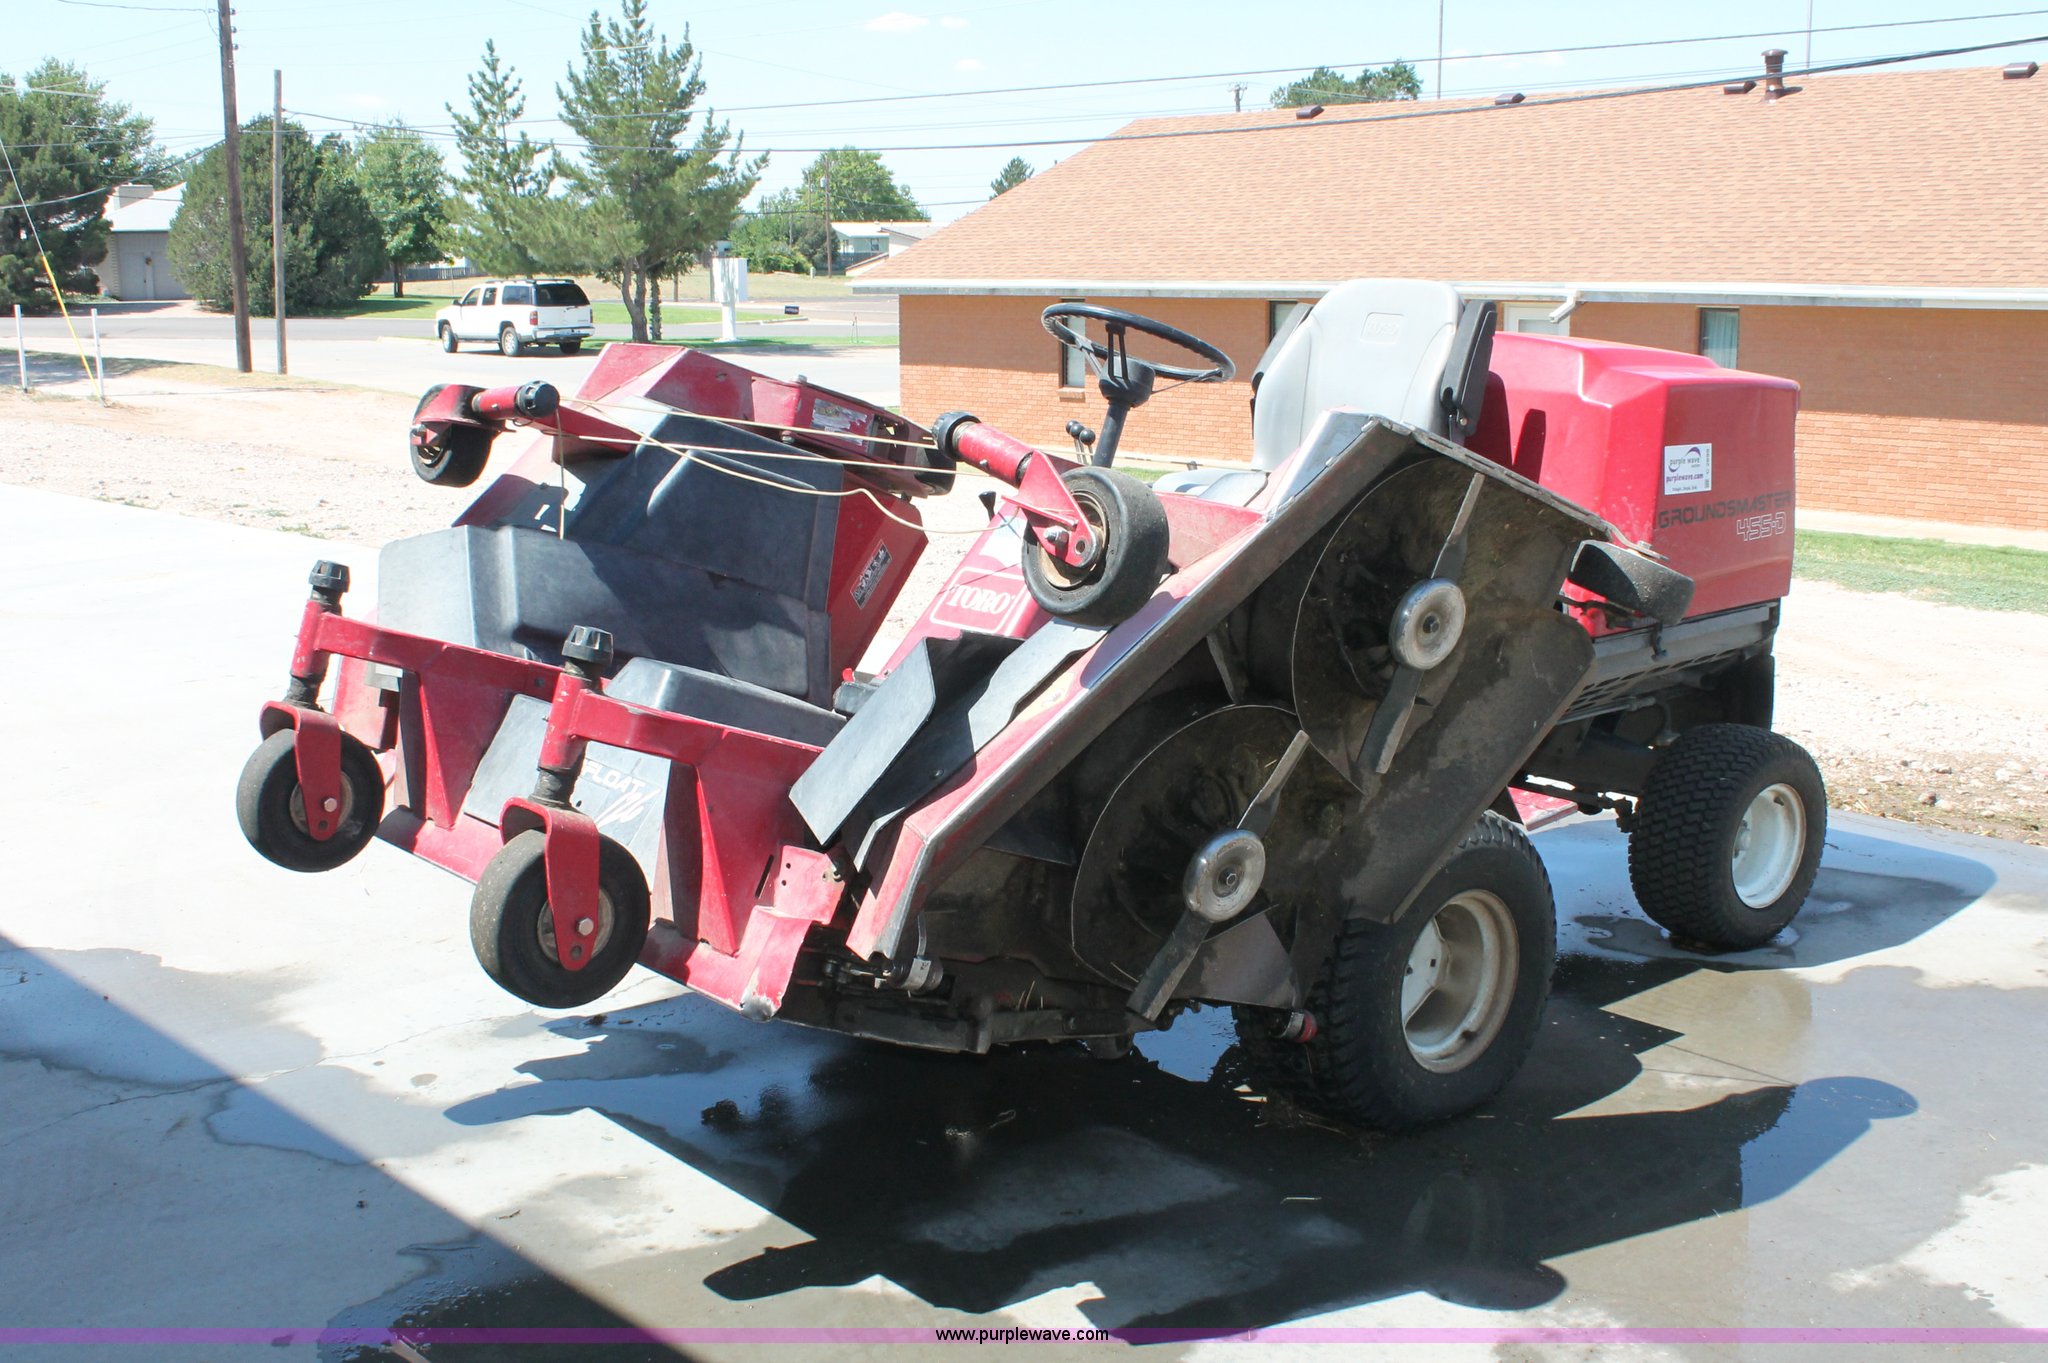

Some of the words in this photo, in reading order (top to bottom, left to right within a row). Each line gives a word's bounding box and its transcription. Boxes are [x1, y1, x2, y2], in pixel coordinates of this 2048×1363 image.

[1666, 473, 1704, 484] purplewave.com
[1658, 491, 1792, 529] GROUNDSMASTER
[947, 585, 1010, 614] TORO
[582, 760, 646, 793] FLOAT
